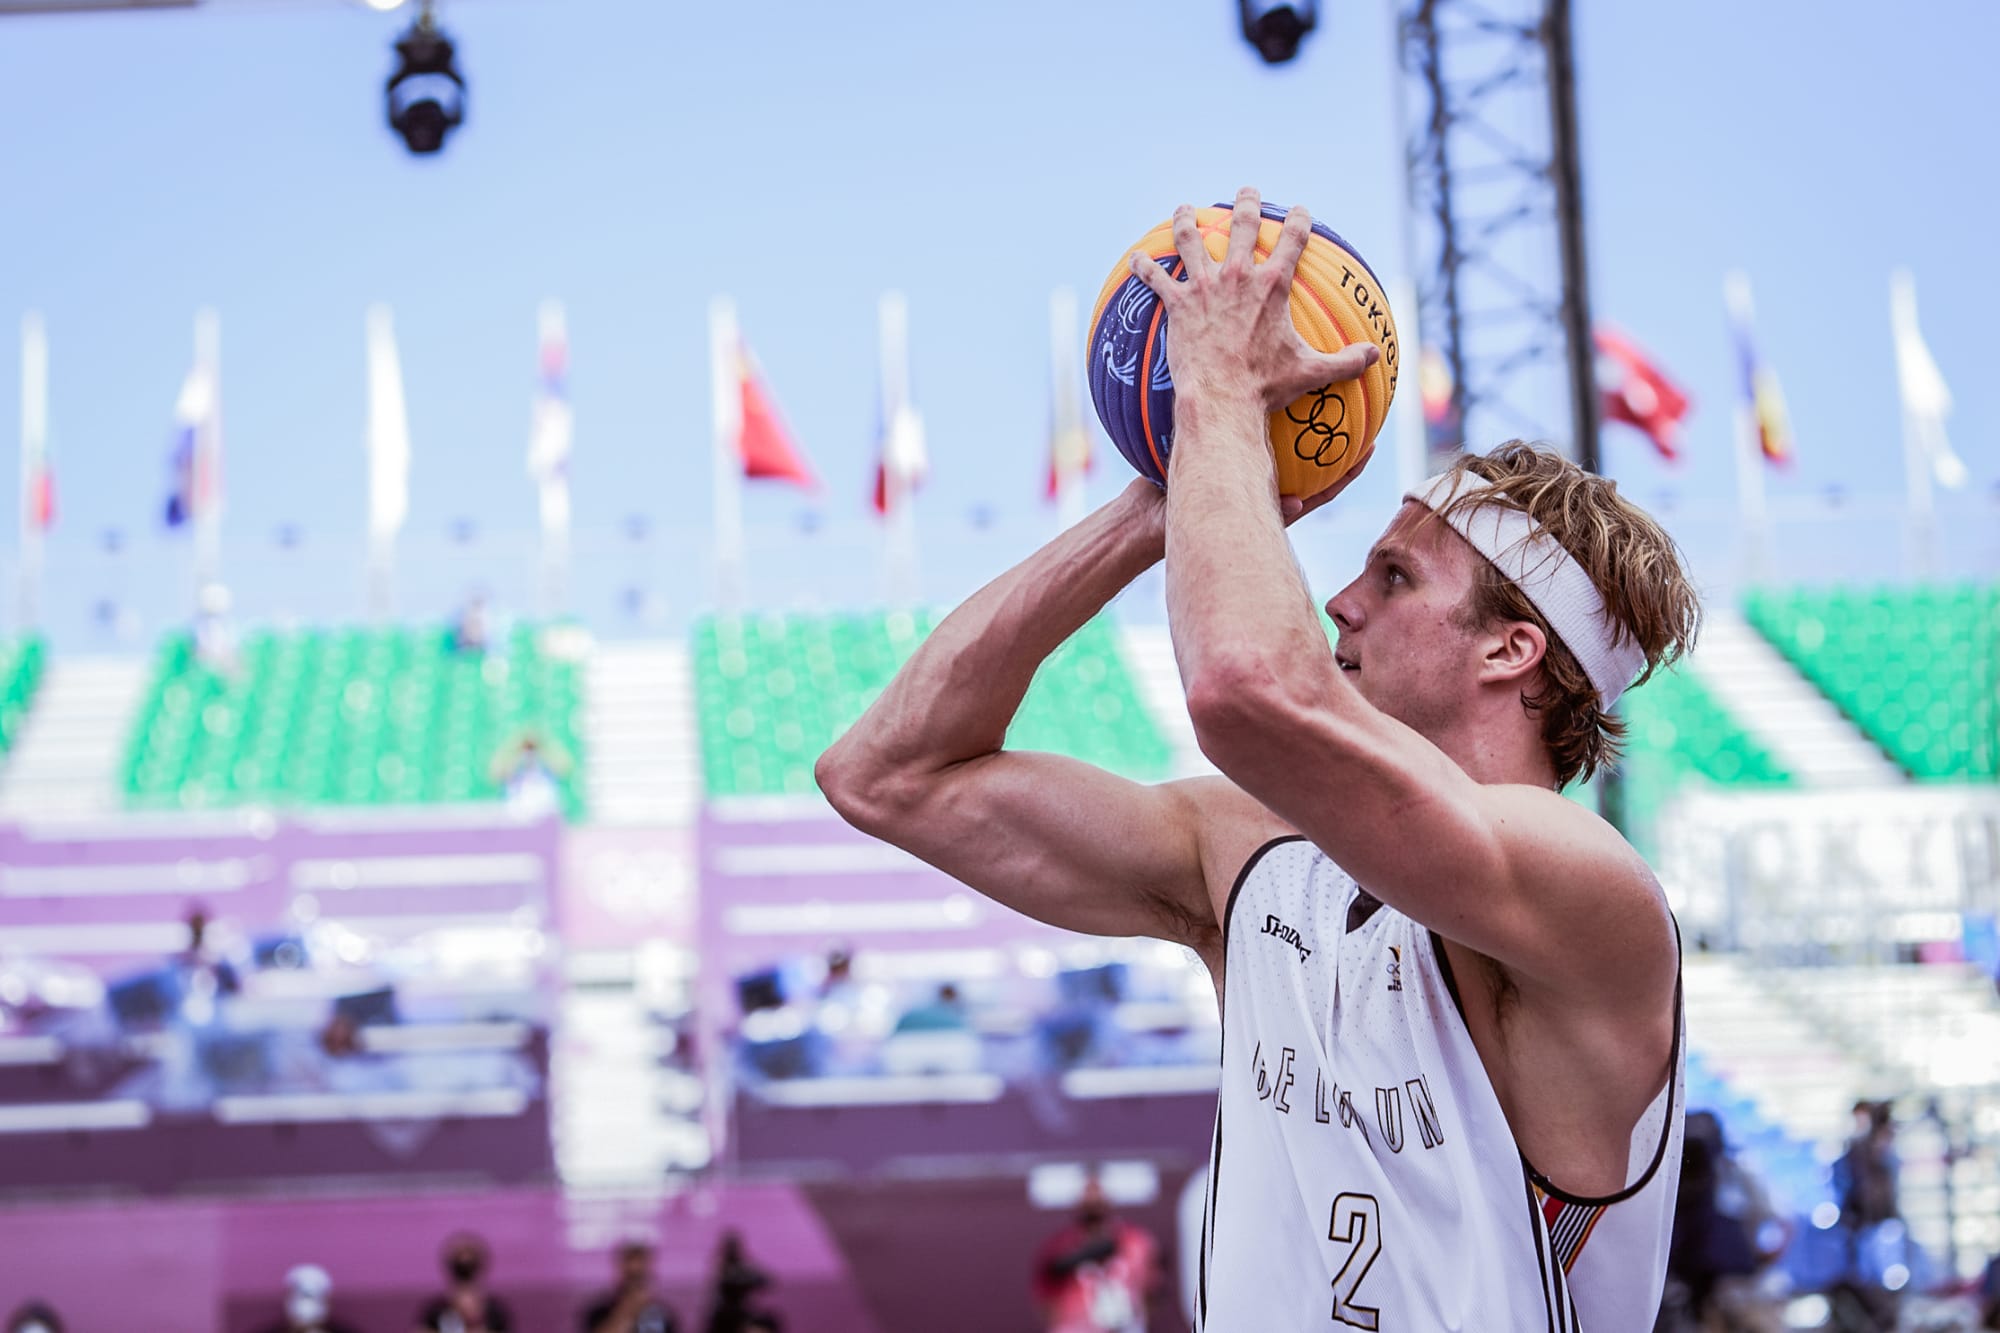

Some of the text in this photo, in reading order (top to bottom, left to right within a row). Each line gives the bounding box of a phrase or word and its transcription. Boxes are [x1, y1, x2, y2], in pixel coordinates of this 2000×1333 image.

[1341, 265, 1397, 366] TOKYO
[1260, 913, 1312, 964] SDING
[1252, 1040, 1444, 1154] BELGU
[1328, 1191, 1382, 1332] 2
